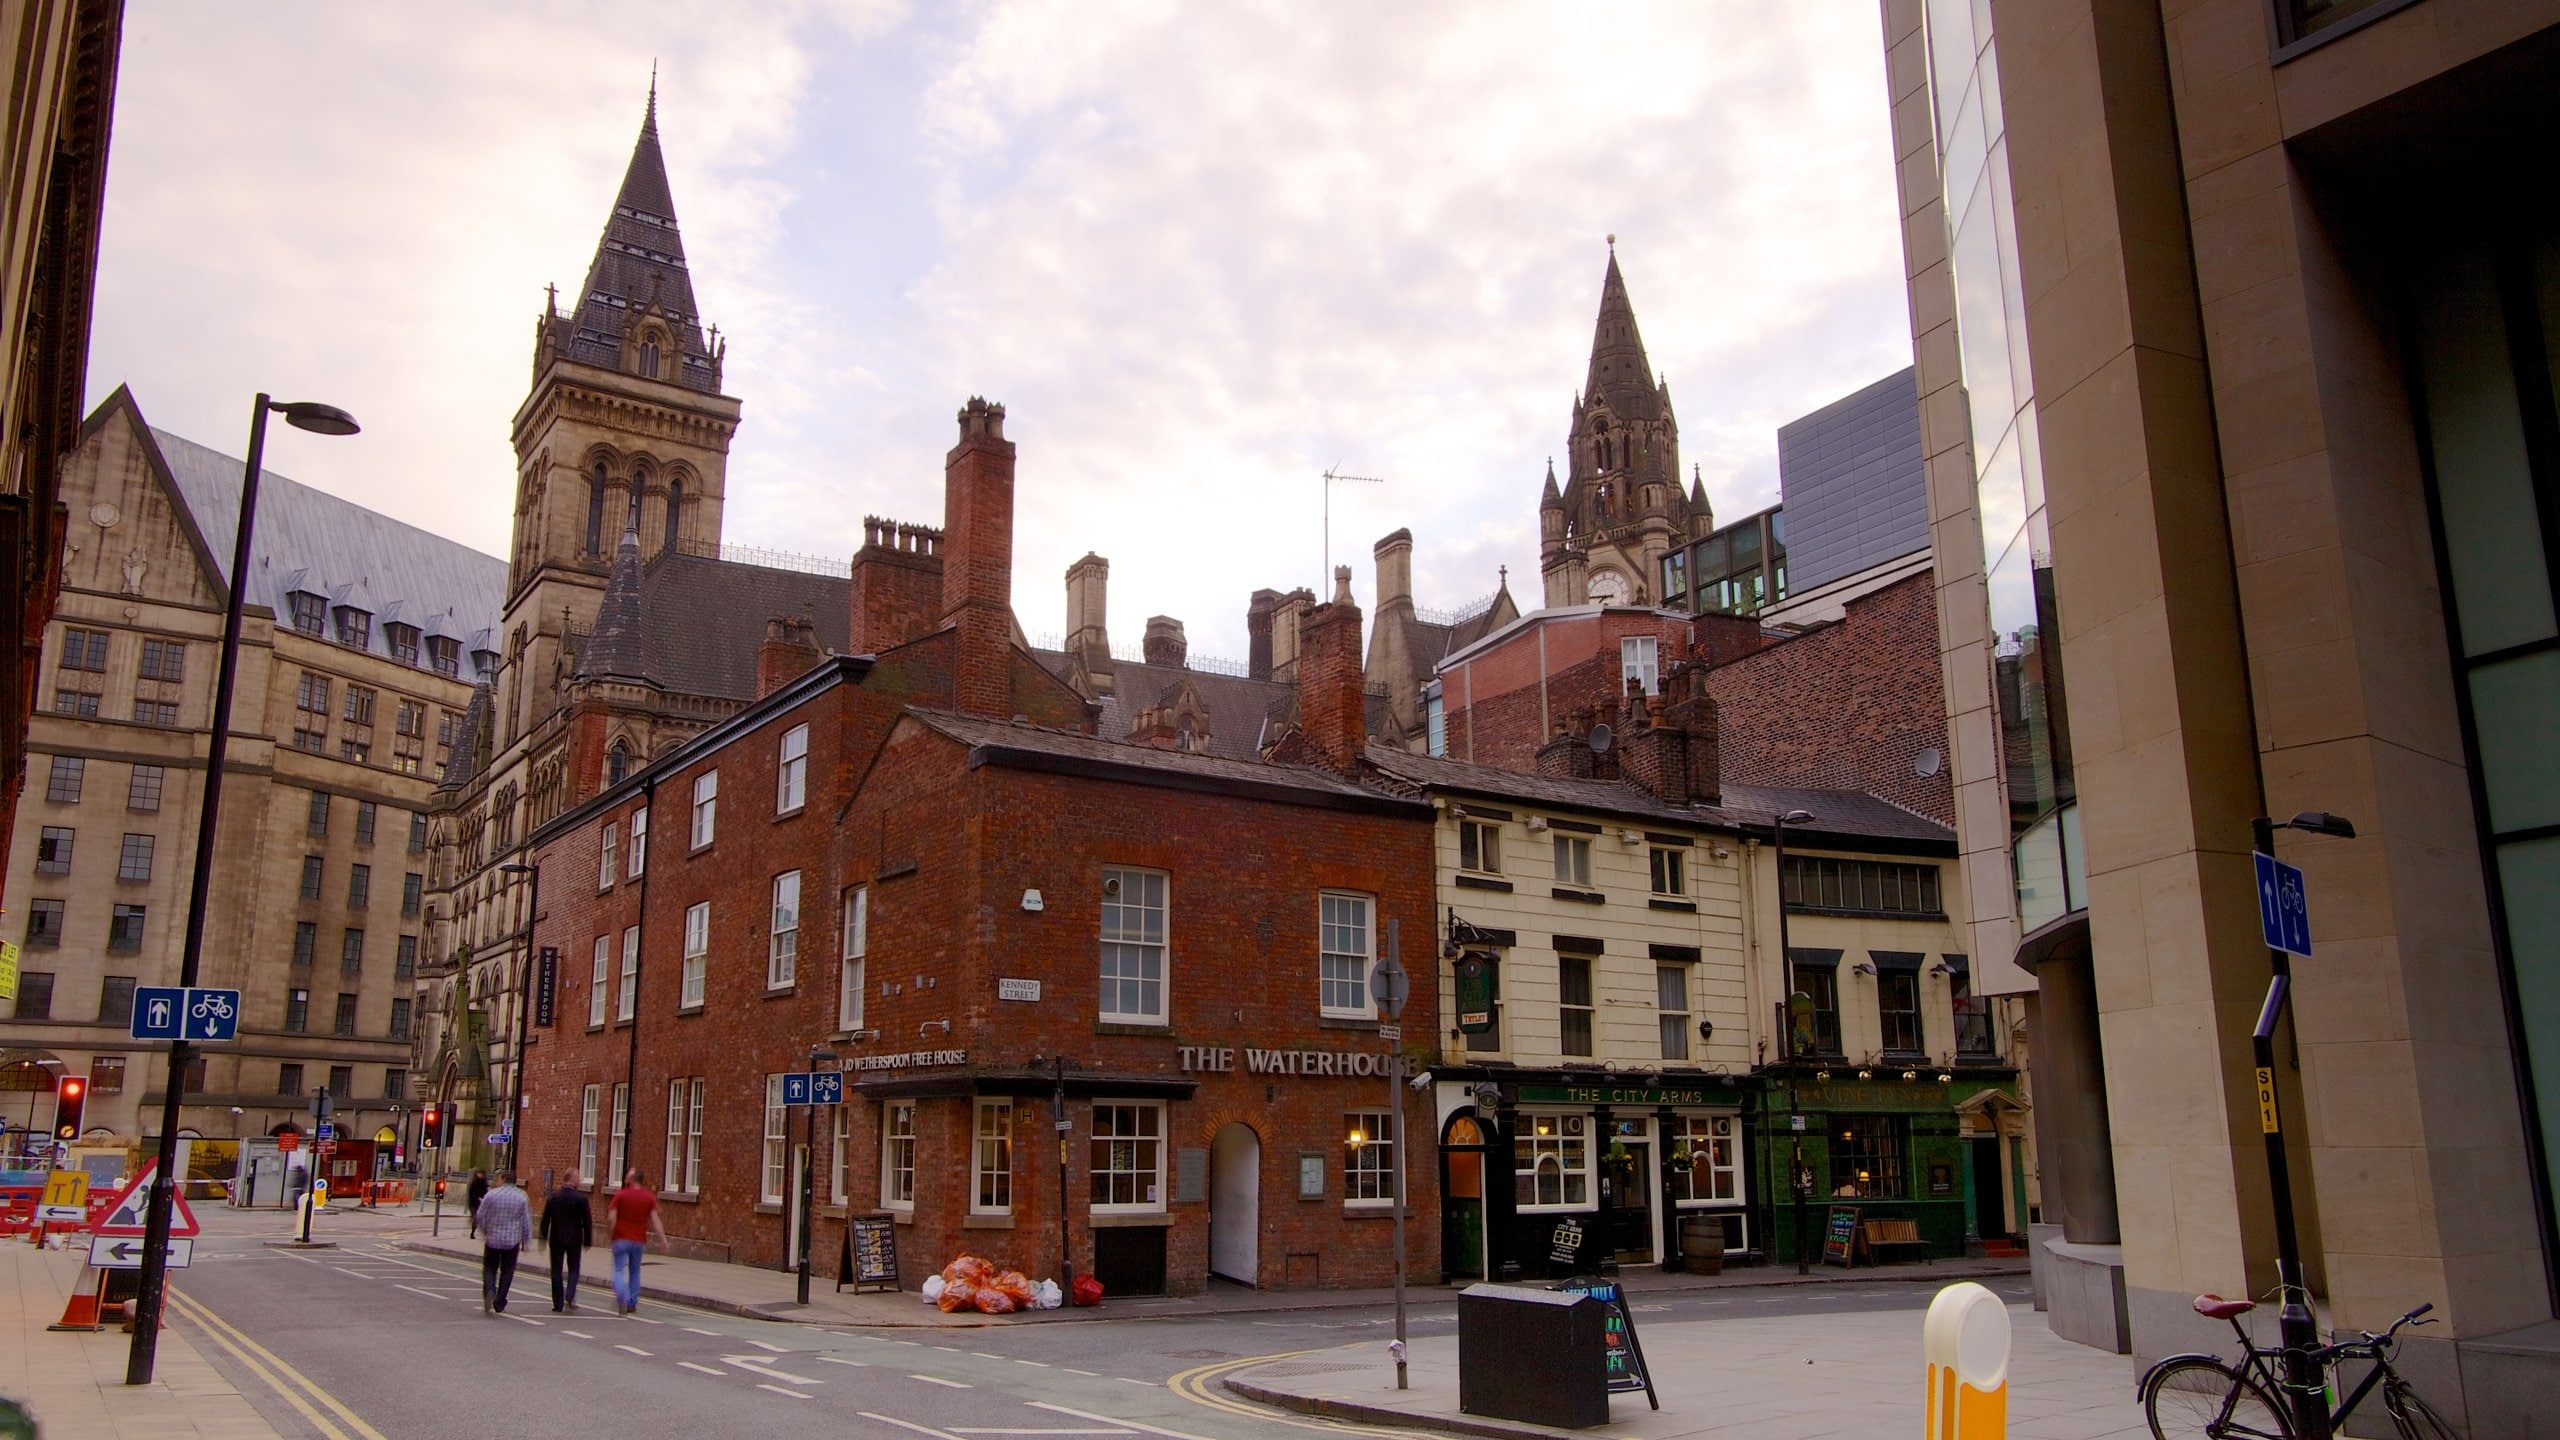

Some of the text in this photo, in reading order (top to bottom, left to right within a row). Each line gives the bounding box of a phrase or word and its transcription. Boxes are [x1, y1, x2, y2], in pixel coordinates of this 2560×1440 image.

[540, 949, 553, 1025] WETHERSPOON
[1000, 979, 1039, 990] KENNEDY
[1003, 989, 1035, 1000] STREET
[838, 1049, 967, 1072] A JD WETHERSPOON FREE HOUSE
[1177, 1046, 1236, 1073] THE
[1567, 1088, 1704, 1104] THE CITY ARMS
[1821, 1085, 1867, 1104] VINE
[1557, 1223, 1570, 1231] CITY
